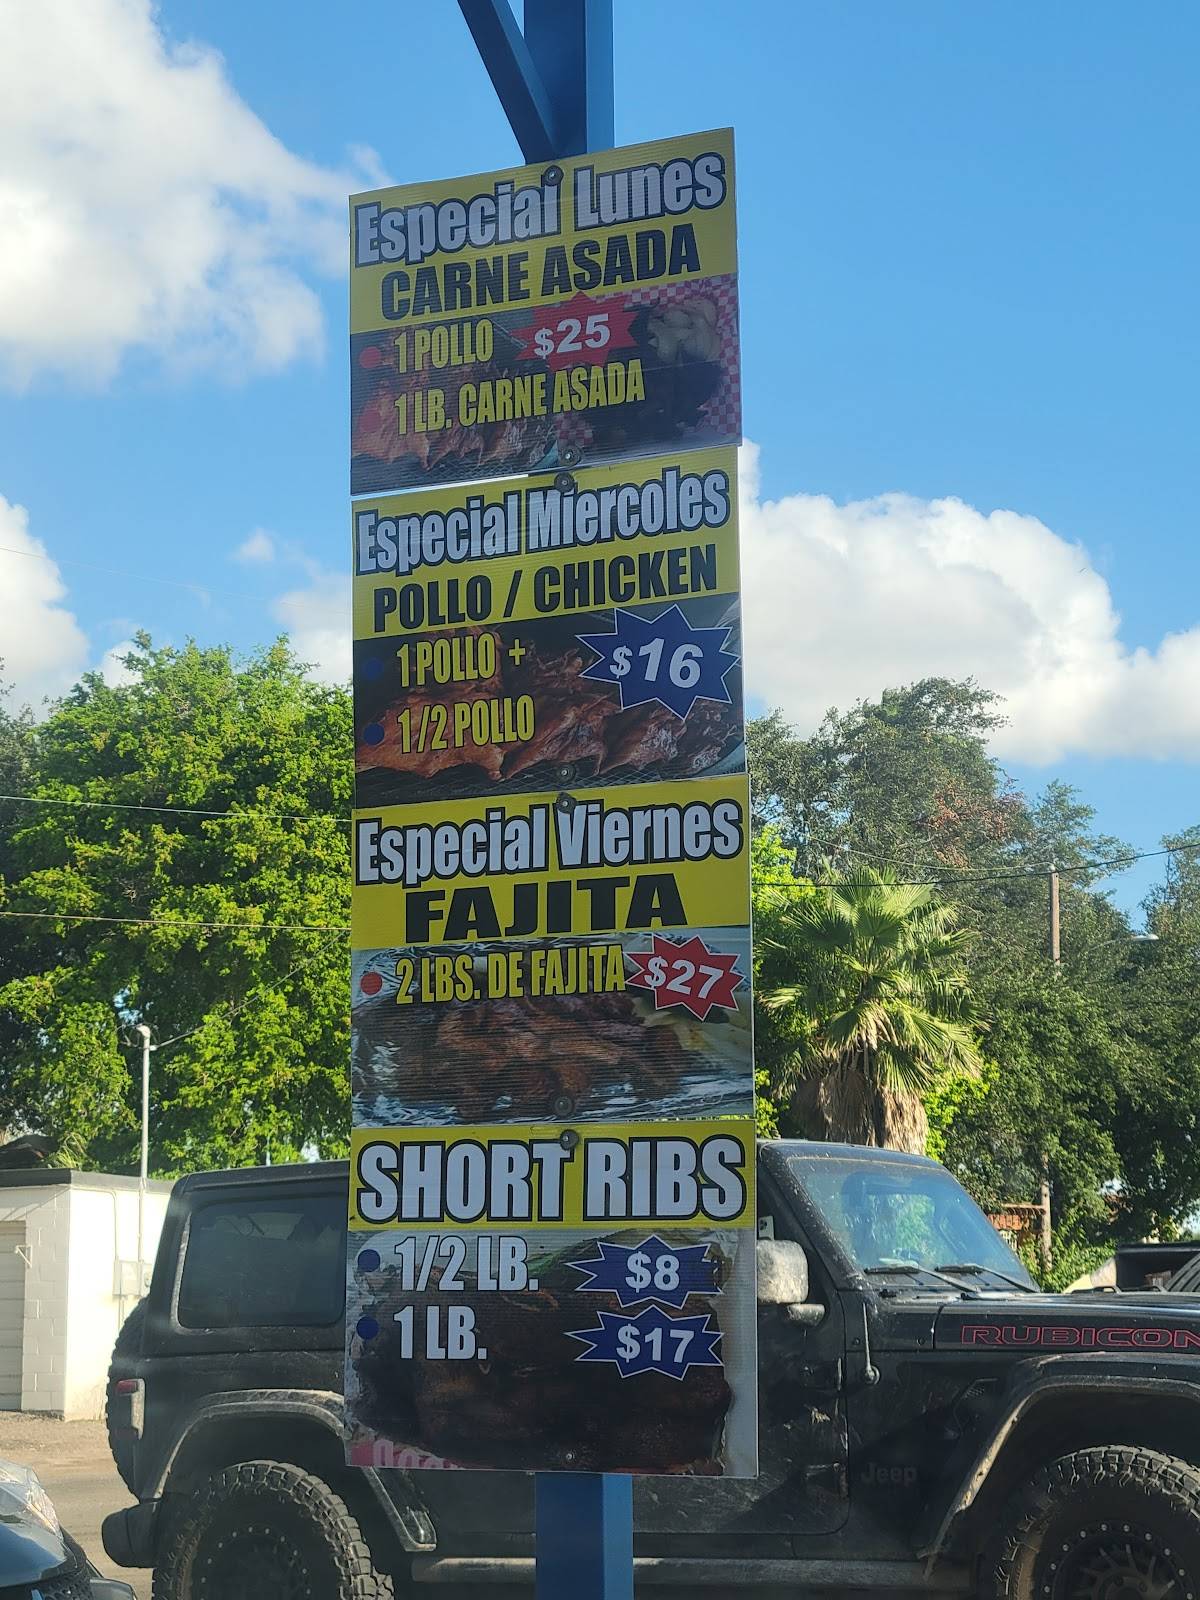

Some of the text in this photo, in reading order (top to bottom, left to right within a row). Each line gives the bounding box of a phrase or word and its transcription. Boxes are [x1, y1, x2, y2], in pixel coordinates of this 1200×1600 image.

[355, 152, 726, 268] Especial Lunes
[381, 223, 701, 320] CARNE ASADA
[394, 318, 494, 374] 1 POLLO
[533, 313, 611, 360] $25
[394, 359, 646, 435] 1 LB. CARNE ASADA
[355, 465, 730, 577] Especial Miercoles
[374, 574, 492, 633] POLLO
[533, 543, 717, 614] CHICKEN
[397, 643, 410, 688] 1
[416, 632, 496, 686] POLLO
[609, 637, 704, 688] $16
[455, 694, 535, 748] POLLO
[356, 798, 743, 889] Especial Viernes
[405, 872, 688, 944] FAJITA
[396, 944, 626, 1004] 2 LBS. DE FAJITA
[647, 956, 723, 1000] $27
[357, 1134, 747, 1224] SHORT RIBS
[394, 1235, 539, 1292] 1/2 LB.
[625, 1251, 680, 1292] $8
[394, 1305, 488, 1360] 1 LB.
[616, 1323, 695, 1363] $17
[861, 1463, 917, 1485] Jeep
